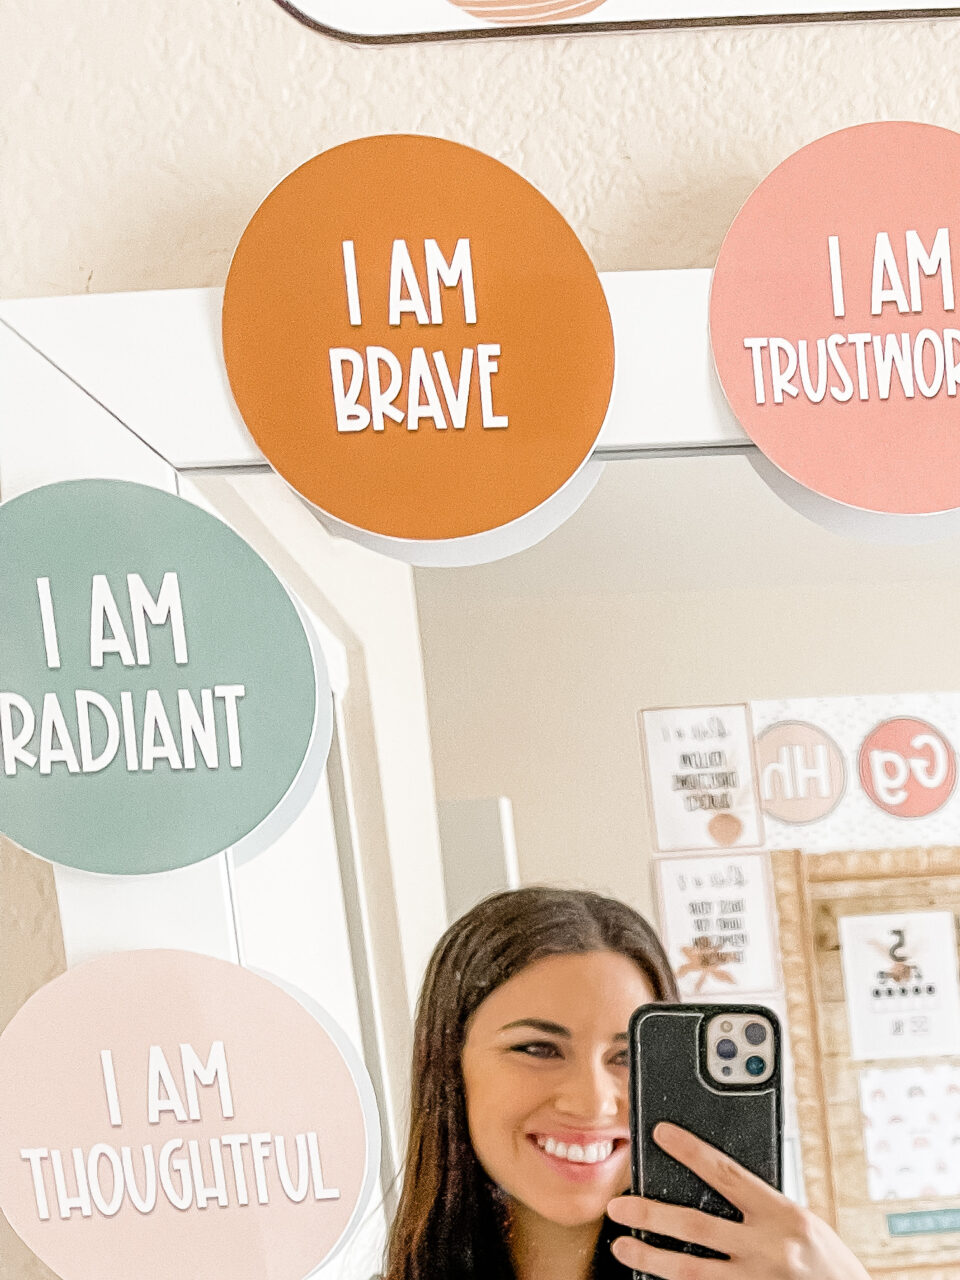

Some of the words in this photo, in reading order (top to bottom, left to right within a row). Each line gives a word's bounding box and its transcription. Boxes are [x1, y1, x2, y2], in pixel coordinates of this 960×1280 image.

[342, 240, 363, 326] I
[388, 238, 477, 325] AM
[828, 235, 845, 317] I
[871, 227, 955, 315] AM
[328, 343, 509, 432] BRAVE
[36, 576, 61, 668] I
[90, 571, 188, 667] AM
[0, 684, 246, 775] RADIANT
[100, 1049, 122, 1125] I
[148, 1040, 234, 1123] AM
[20, 1131, 340, 1219] THOUGHTFUL
